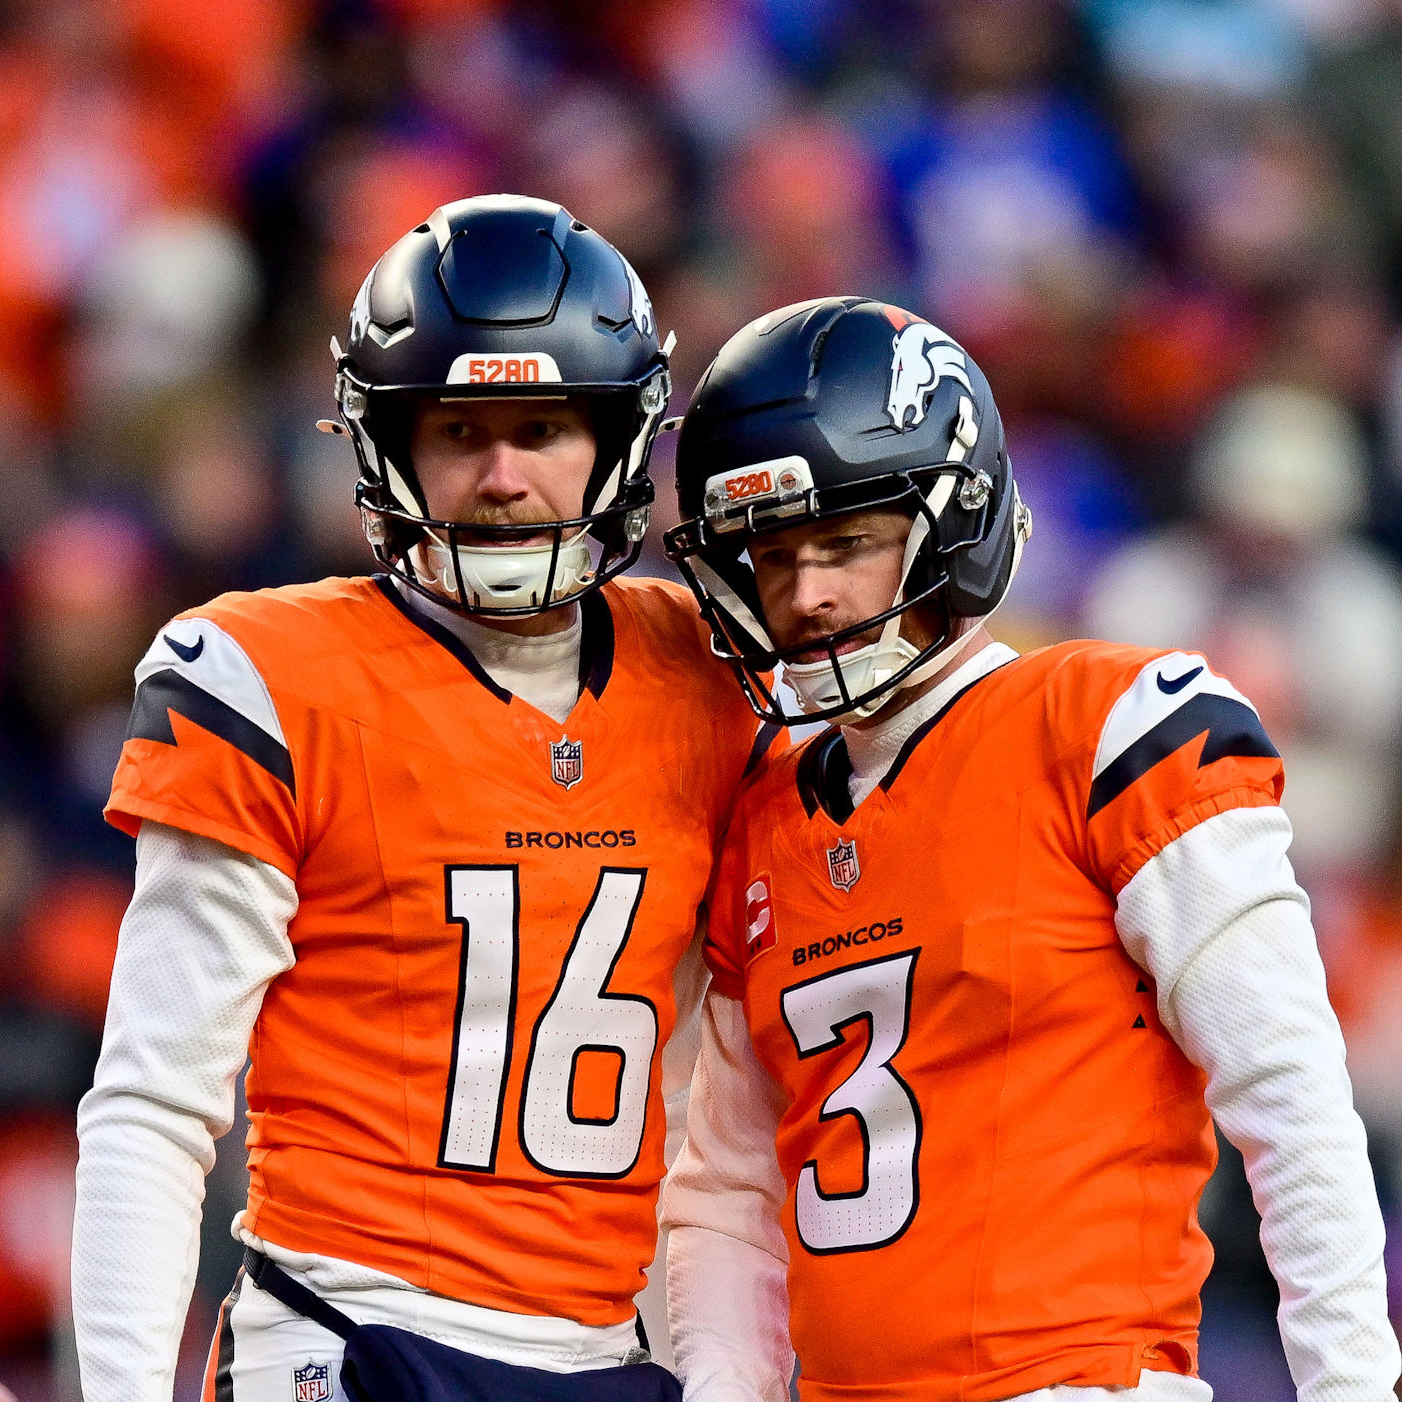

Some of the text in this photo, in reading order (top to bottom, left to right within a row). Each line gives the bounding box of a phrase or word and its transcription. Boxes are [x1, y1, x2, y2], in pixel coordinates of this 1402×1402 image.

[469, 359, 539, 384] 5280
[725, 470, 772, 500] 5280
[556, 761, 579, 780] NFL
[505, 830, 636, 849] BRONCOS
[833, 861, 856, 882] NFL
[792, 918, 903, 966] BRONCOS
[435, 864, 659, 1180] 16
[782, 947, 923, 1256] 3
[298, 1381, 326, 1401] NFL
